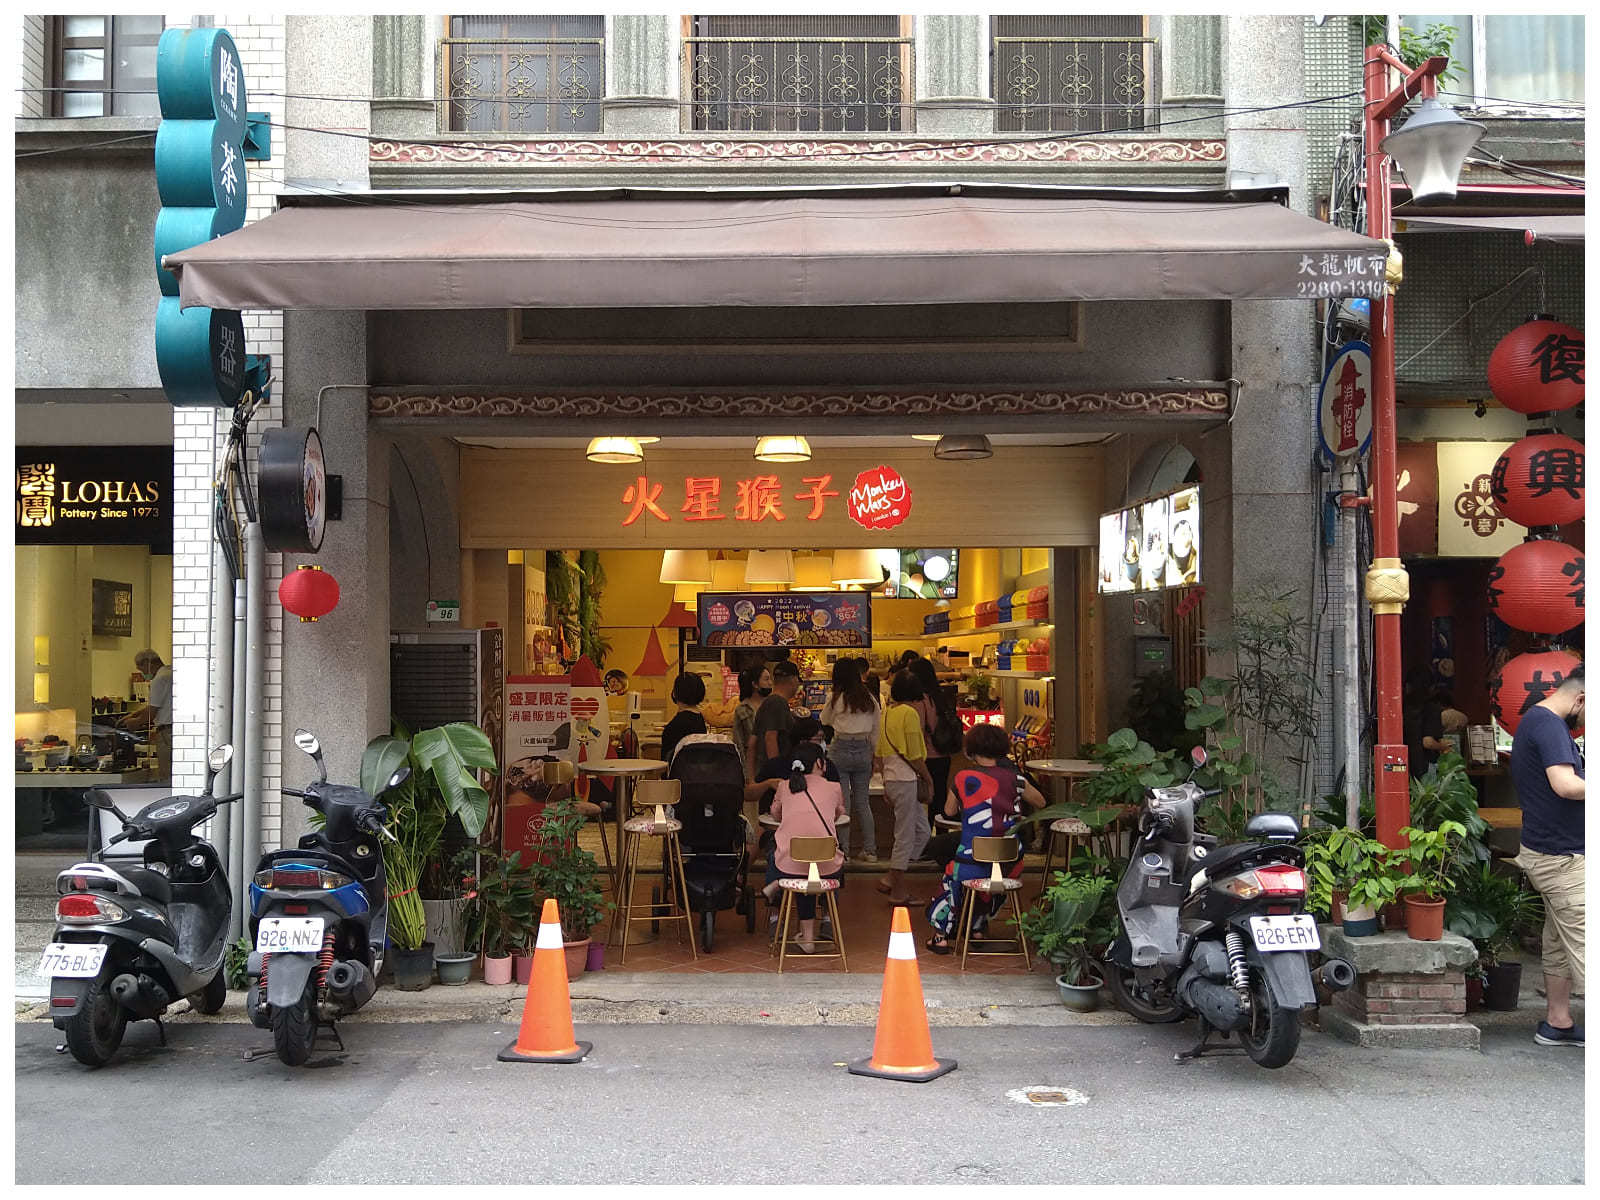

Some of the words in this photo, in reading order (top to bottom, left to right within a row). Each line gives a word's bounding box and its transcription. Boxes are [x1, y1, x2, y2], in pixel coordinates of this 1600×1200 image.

[220, 46, 238, 111] 陶
[220, 141, 238, 196] 茶
[1297, 253, 1385, 276] 大龍帆布
[220, 325, 236, 377] 器
[1529, 334, 1585, 384] 復
[1343, 382, 1354, 438] 消防栓
[1525, 448, 1585, 500] 興
[60, 480, 159, 503] LOHAS
[621, 474, 840, 527] 火星猴子
[851, 473, 906, 506] Monkey
[60, 507, 97, 520] Pottery
[100, 507, 128, 518] Since
[132, 507, 159, 518] 1973
[856, 494, 892, 519] Mars
[440, 609, 453, 619] 96
[782, 610, 808, 623] 中秋
[509, 691, 569, 706] 盛夏限定
[509, 710, 567, 722] 消暑販售中
[260, 928, 320, 947] 928-NNZ
[1256, 926, 1314, 945] 826-ERY
[43, 954, 101, 972] 775-BLS
